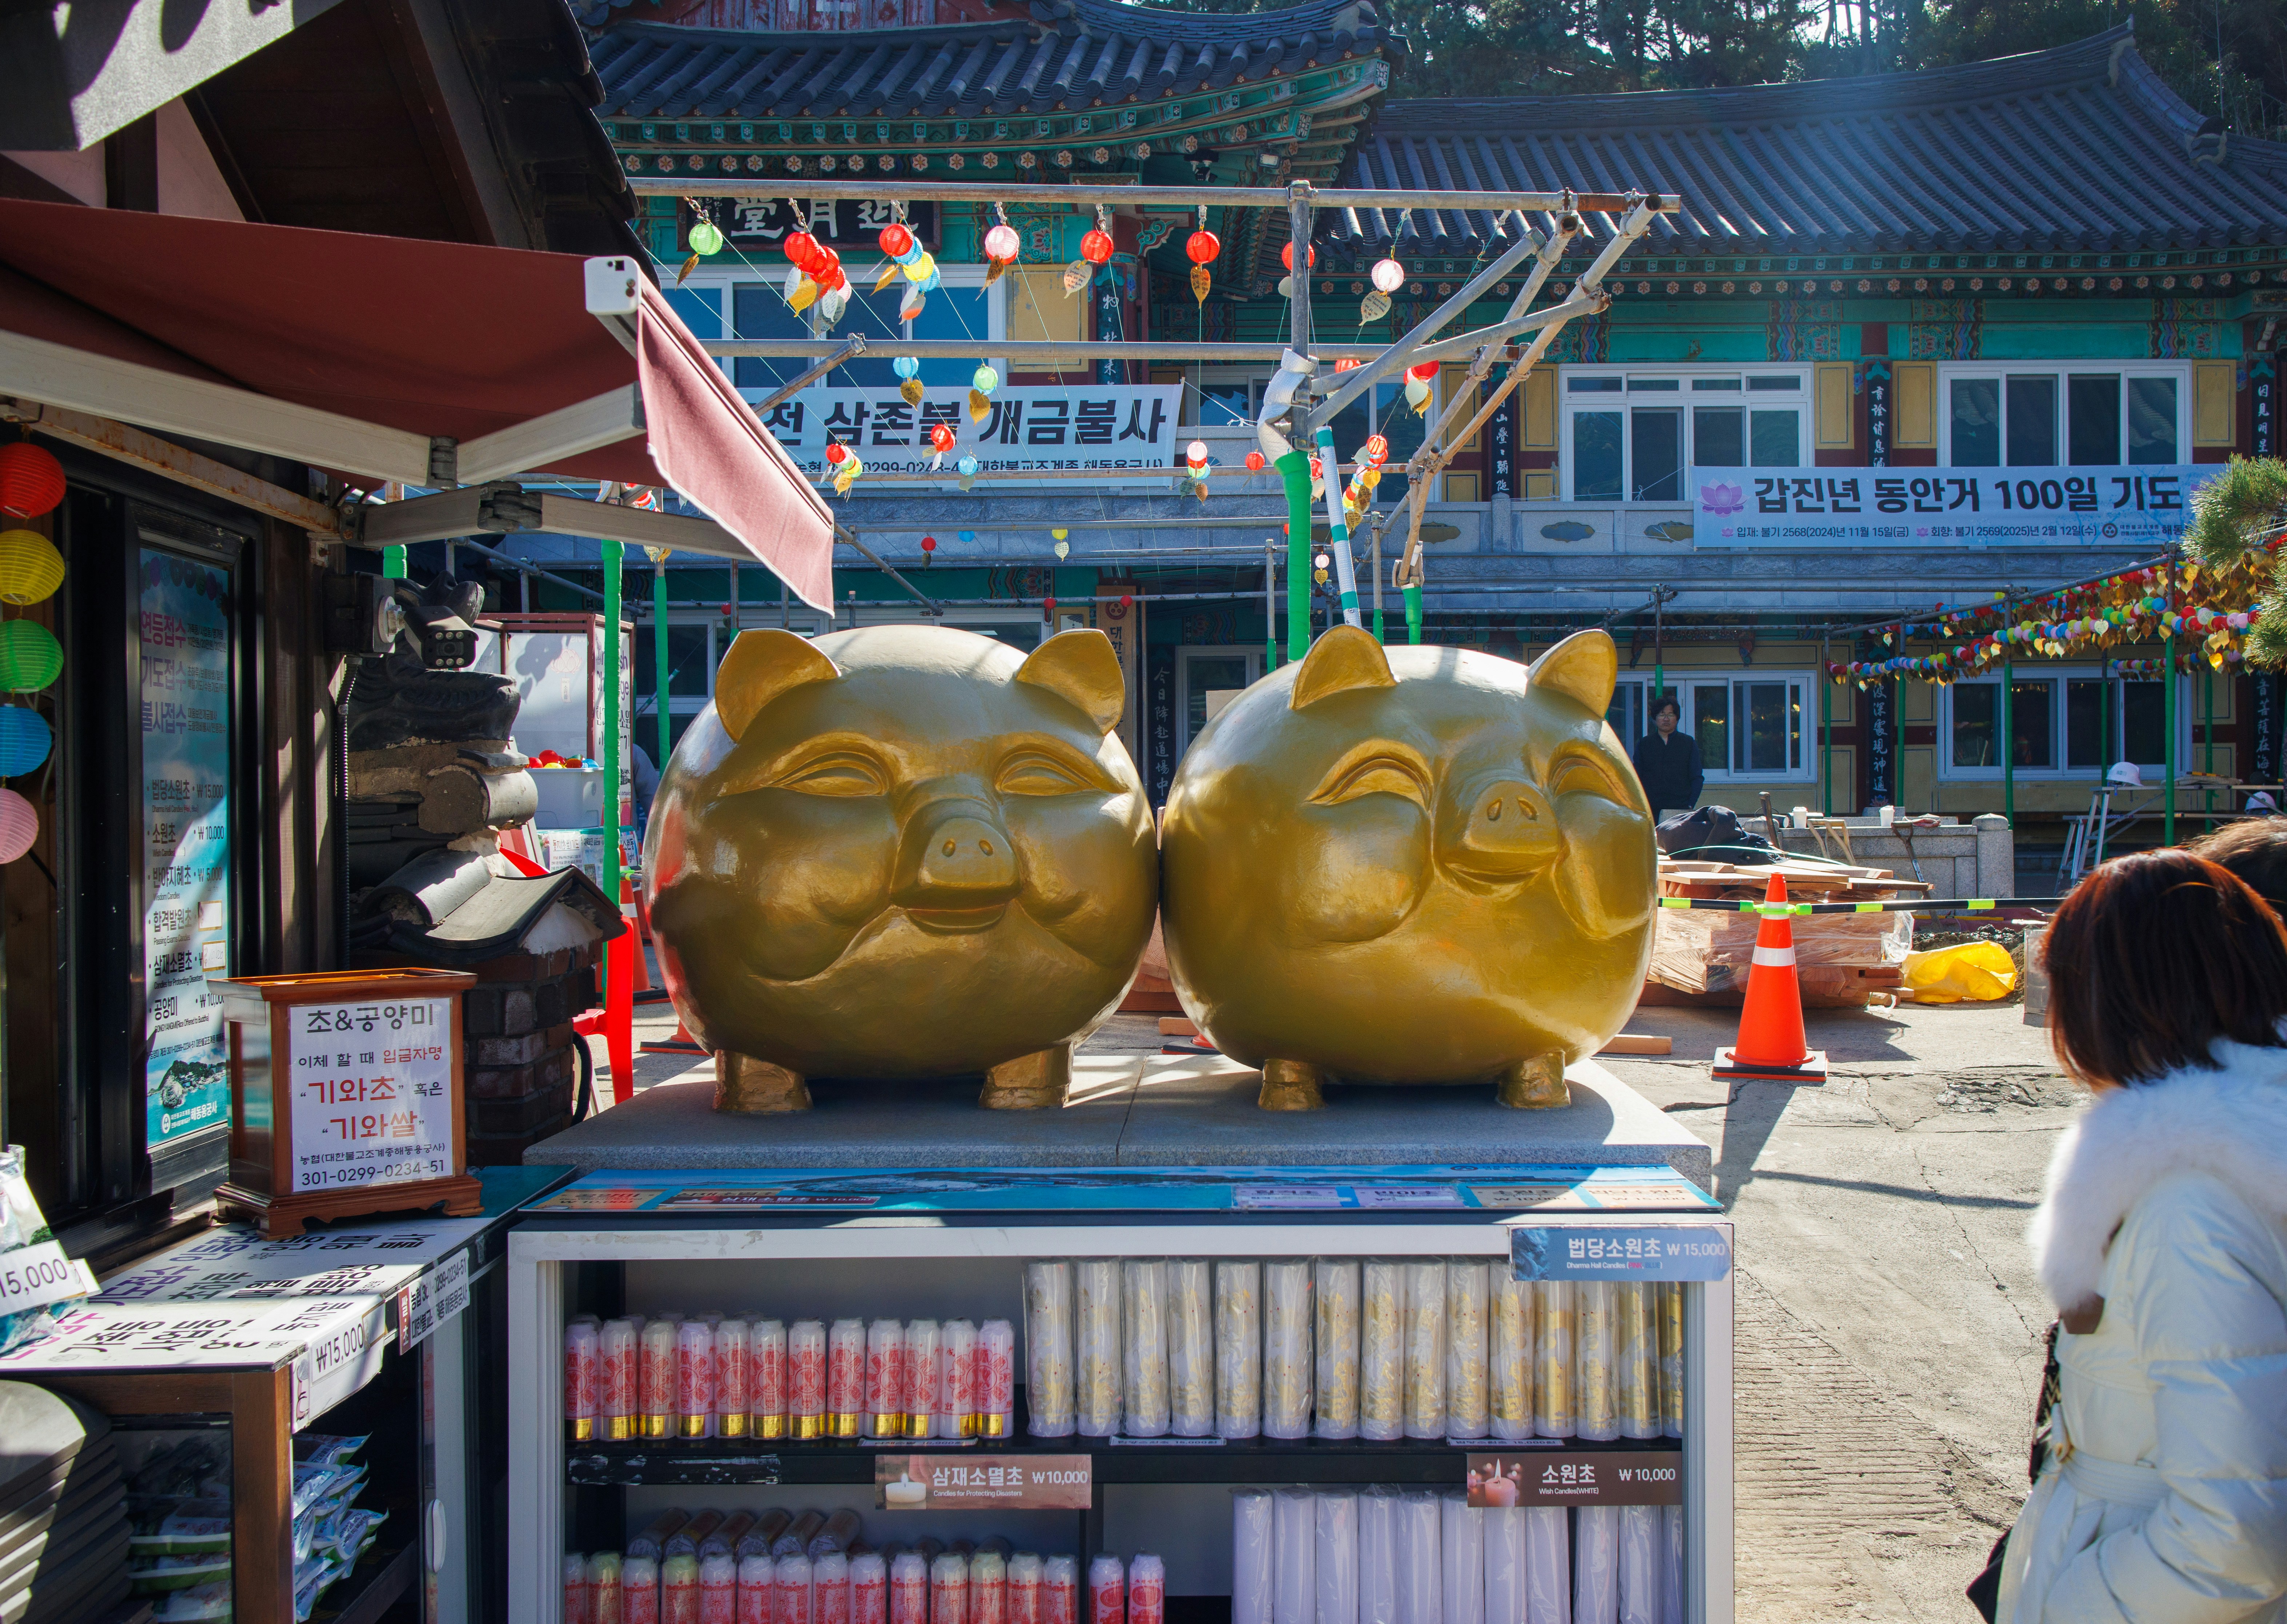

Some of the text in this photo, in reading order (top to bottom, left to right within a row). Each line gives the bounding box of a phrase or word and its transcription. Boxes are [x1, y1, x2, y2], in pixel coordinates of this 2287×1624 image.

[824, 402, 961, 446] 삼존불
[979, 398, 1166, 445] 개금불사
[1754, 476, 2183, 513] 갑진년 동안거 100일 기도
[1737, 525, 2097, 538] 입재: 불기 2568(2024)년 11월 15일(금) 회향: 불기 2569(2025)년 2월 12일(수)
[141, 656, 187, 692] 기도접수
[141, 699, 187, 734] 불사접수
[152, 779, 191, 801] 법당소원초
[204, 784, 224, 799] 15,000
[152, 822, 176, 844] 소원초
[205, 825, 224, 842] 10,000
[153, 865, 192, 889] 반야지혜초
[207, 867, 222, 883] 5,000
[168, 892, 180, 901] Candles
[153, 907, 192, 933] 합격발원초
[154, 934, 191, 946] Passing Exams Candles
[154, 950, 192, 977] 삼재소멸초
[154, 995, 177, 1021] 공양미
[307, 1004, 433, 1033] 초&공양미
[298, 1046, 442, 1068] 이체 할 때 입금자명
[413, 1081, 443, 1097] 혹은
[190, 1100, 217, 1121] 해동용궁사
[301, 1160, 444, 1186] 301-0299-0234-51
[319, 1235, 382, 1249] 위패
[374, 1234, 435, 1248] 불사
[1568, 1238, 1661, 1259] 법당소원초
[1684, 1243, 1725, 1257] 15,000
[168, 1272, 252, 1299] 초하루
[226, 1280, 302, 1298] 매월
[411, 1286, 422, 1311] 농협
[445, 1282, 467, 1314] 해동용궁사
[59, 1321, 165, 1352] 가족등
[132, 1320, 231, 1350] 사업등
[316, 1323, 364, 1373] ₩15,000
[933, 1466, 1023, 1487] 삼재소멸초
[1542, 1464, 1596, 1484] 소원초
[1635, 1468, 1676, 1482] 10,000
